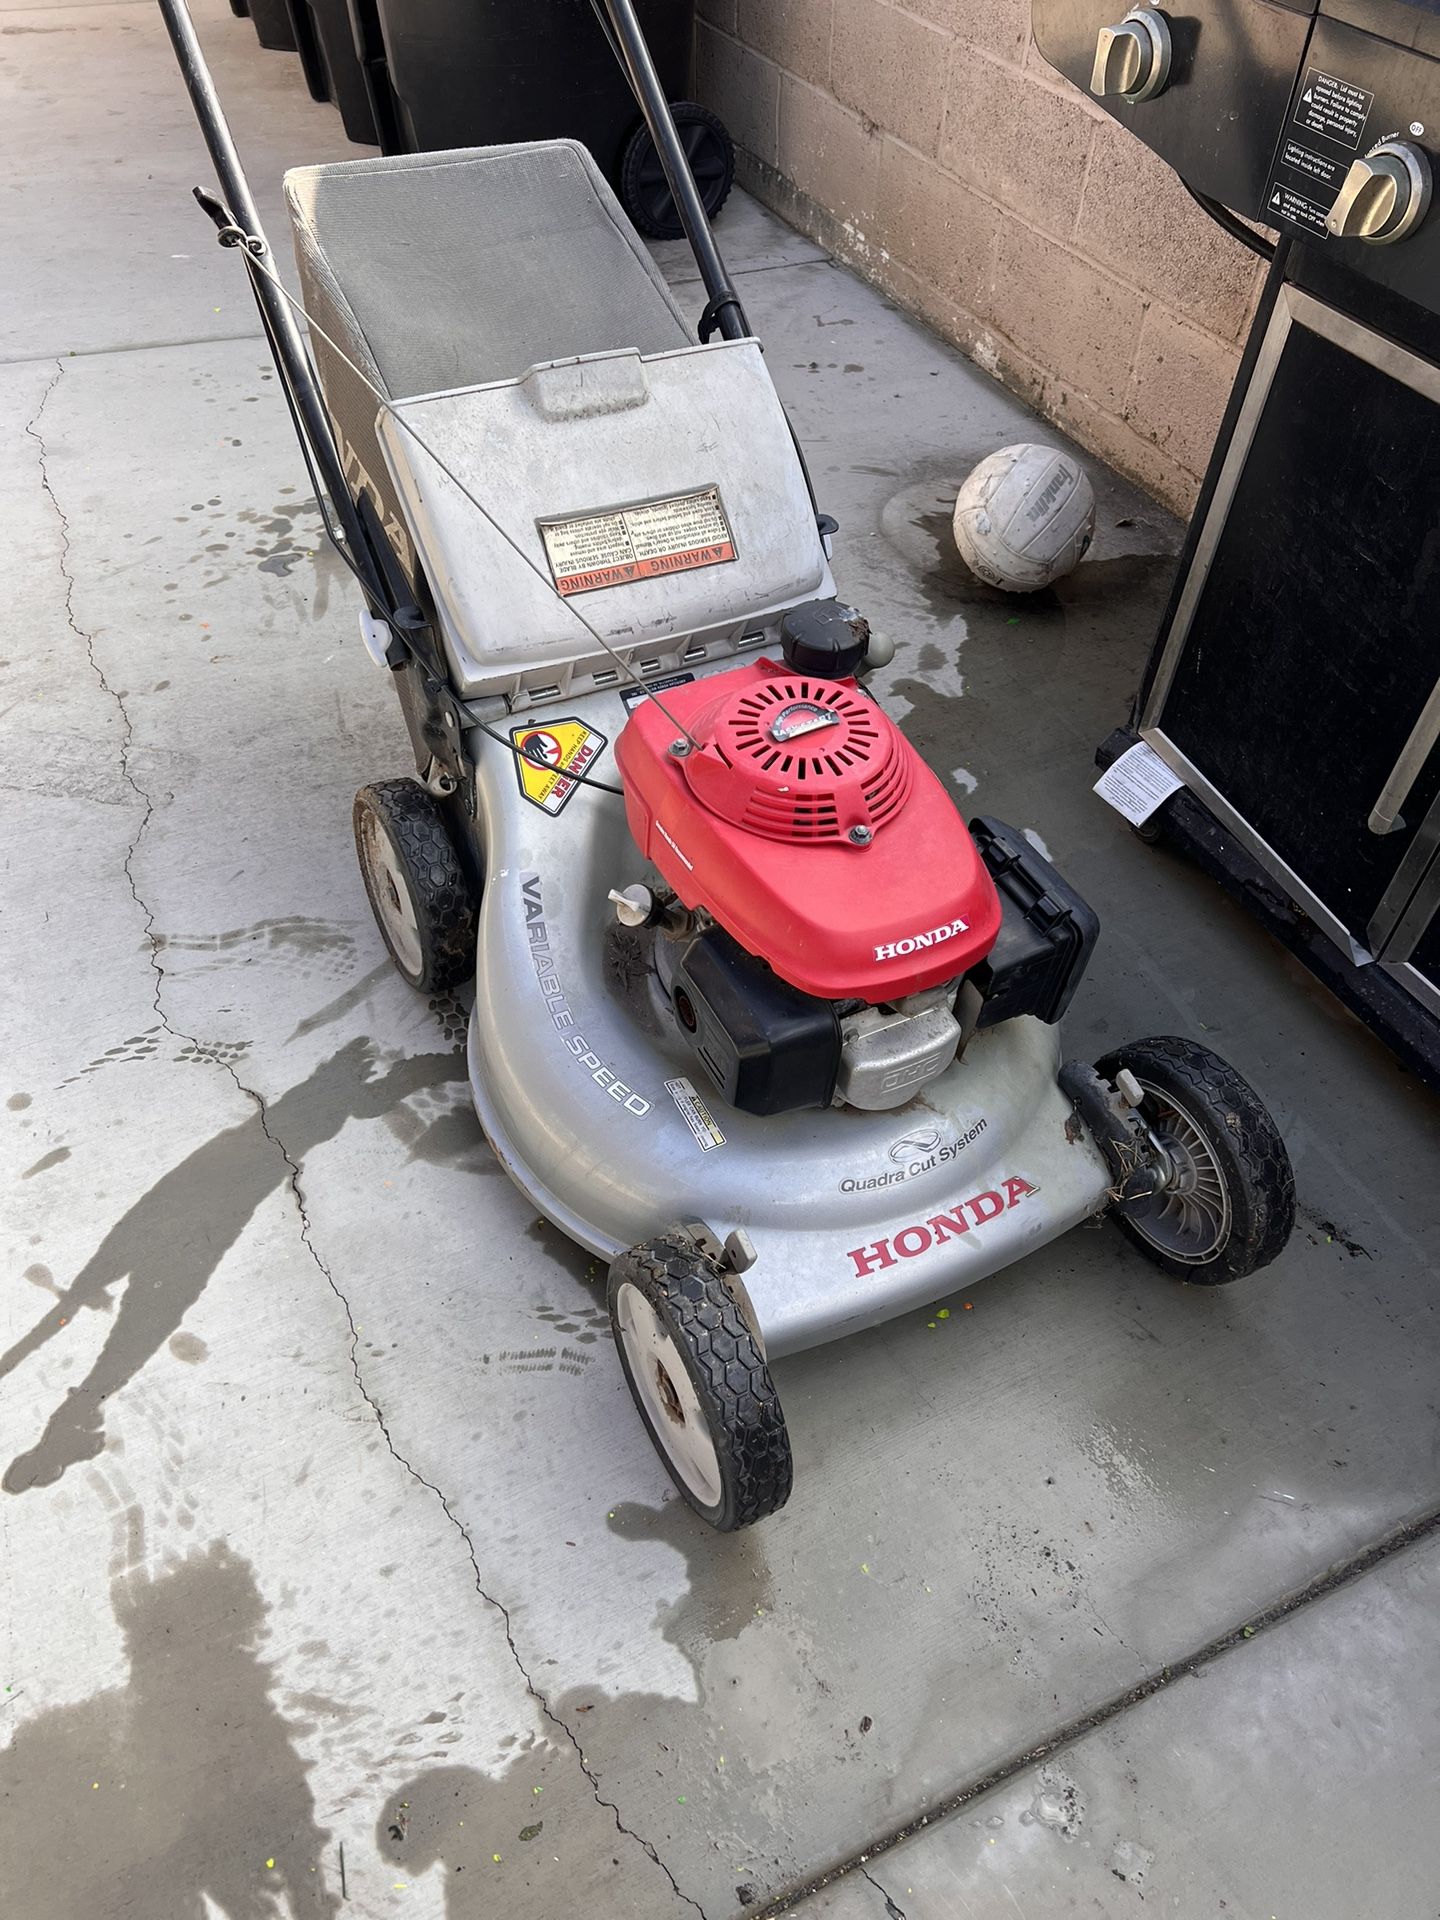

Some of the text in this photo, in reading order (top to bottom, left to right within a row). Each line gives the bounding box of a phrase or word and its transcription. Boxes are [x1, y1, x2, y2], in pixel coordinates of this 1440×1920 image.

[1340, 85, 1348, 93] Lid
[1347, 89, 1358, 97] must
[1331, 91, 1346, 102] before
[1346, 97, 1362, 111] lighting
[1311, 102, 1323, 111] could
[1323, 108, 1334, 116] result
[1338, 115, 1358, 127] property
[1330, 100, 1344, 111] Failure
[1350, 110, 1367, 122] comply
[1326, 119, 1344, 130] personal
[1381, 131, 1400, 143] Burner
[1287, 144, 1304, 158] Lighting
[1304, 153, 1328, 168] instructions
[1285, 152, 1301, 165] located
[1301, 161, 1313, 171] inside
[1321, 171, 1331, 179] door.
[668, 542, 687, 550] INJURY
[688, 536, 711, 546] SERIOUS
[575, 554, 599, 564] SERIOUS
[586, 558, 611, 567] THROWN
[600, 550, 619, 559] CAUSE
[612, 553, 633, 563] OBJECT
[650, 549, 712, 571] WARNING
[559, 565, 577, 573] BLADE
[560, 569, 623, 591] WARNING
[781, 702, 818, 718] Performance
[576, 731, 587, 745] KEEP
[563, 744, 578, 762] HANDS
[548, 771, 559, 785] EET
[538, 784, 550, 799] AWAY
[874, 918, 969, 962] HONDA
[522, 875, 652, 1119] VARIABLE SPEED
[695, 1100, 712, 1126] CAUTION
[840, 1117, 988, 1193] Quadra Cut System
[847, 1175, 1040, 1278] HONDA
